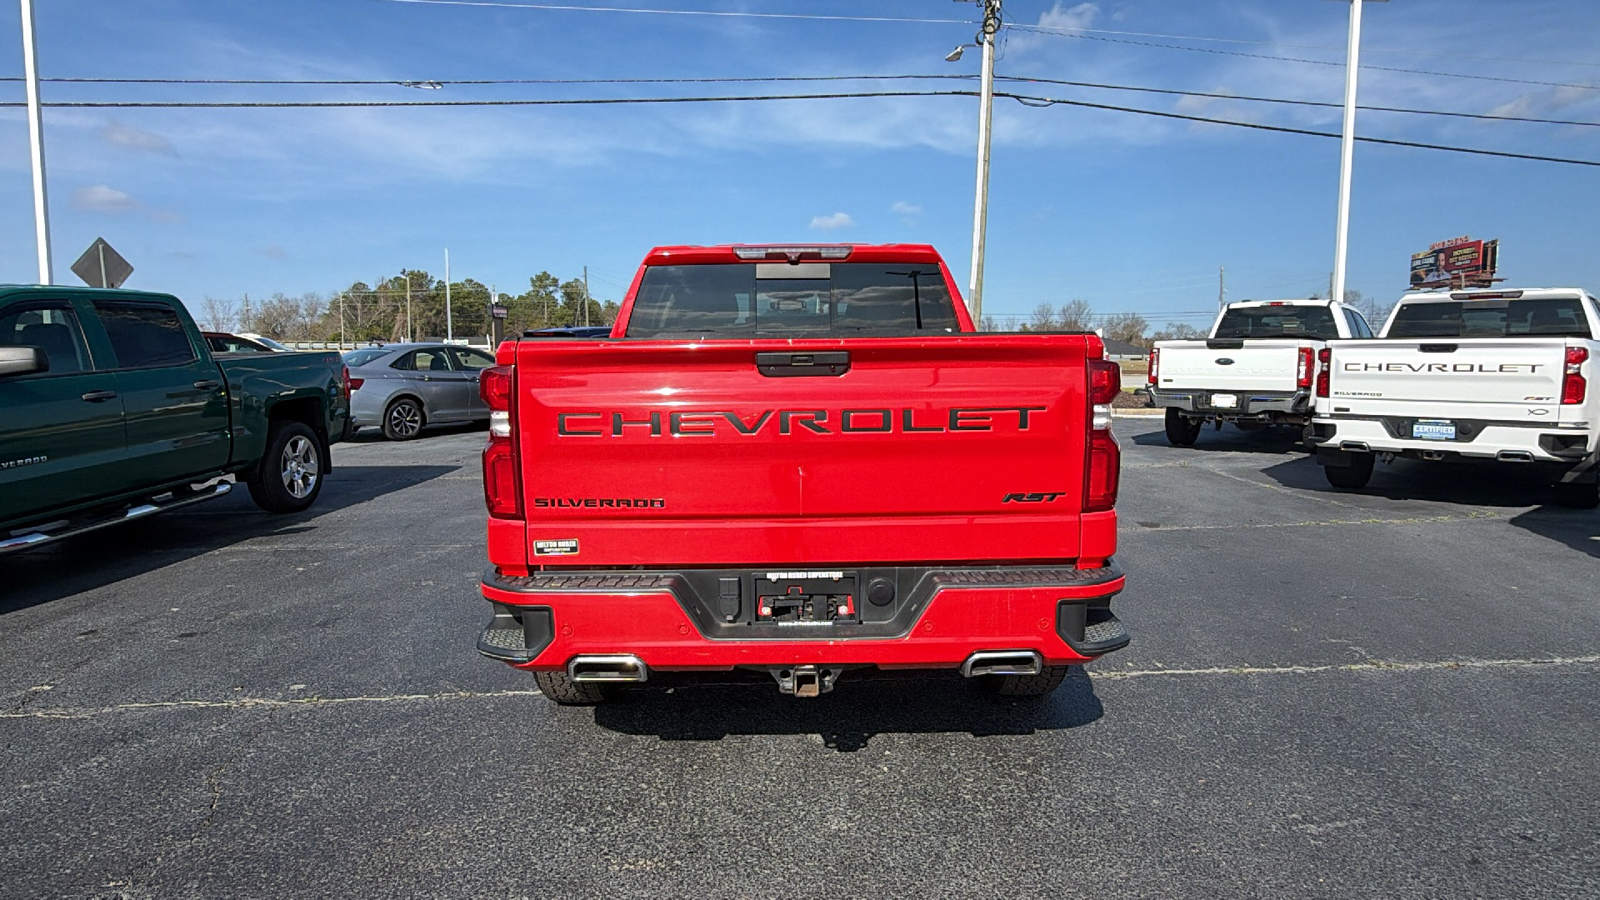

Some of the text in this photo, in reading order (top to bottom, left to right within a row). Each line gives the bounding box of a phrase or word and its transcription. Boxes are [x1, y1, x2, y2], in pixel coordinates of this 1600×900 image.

[1344, 363, 1544, 373] CHEVROLET
[558, 406, 1047, 438] CHEVROLET
[1414, 425, 1453, 433] CERTIFIED
[0, 455, 48, 470] VERADO
[534, 497, 665, 508] SILVERADO
[1001, 491, 1067, 503] RST
